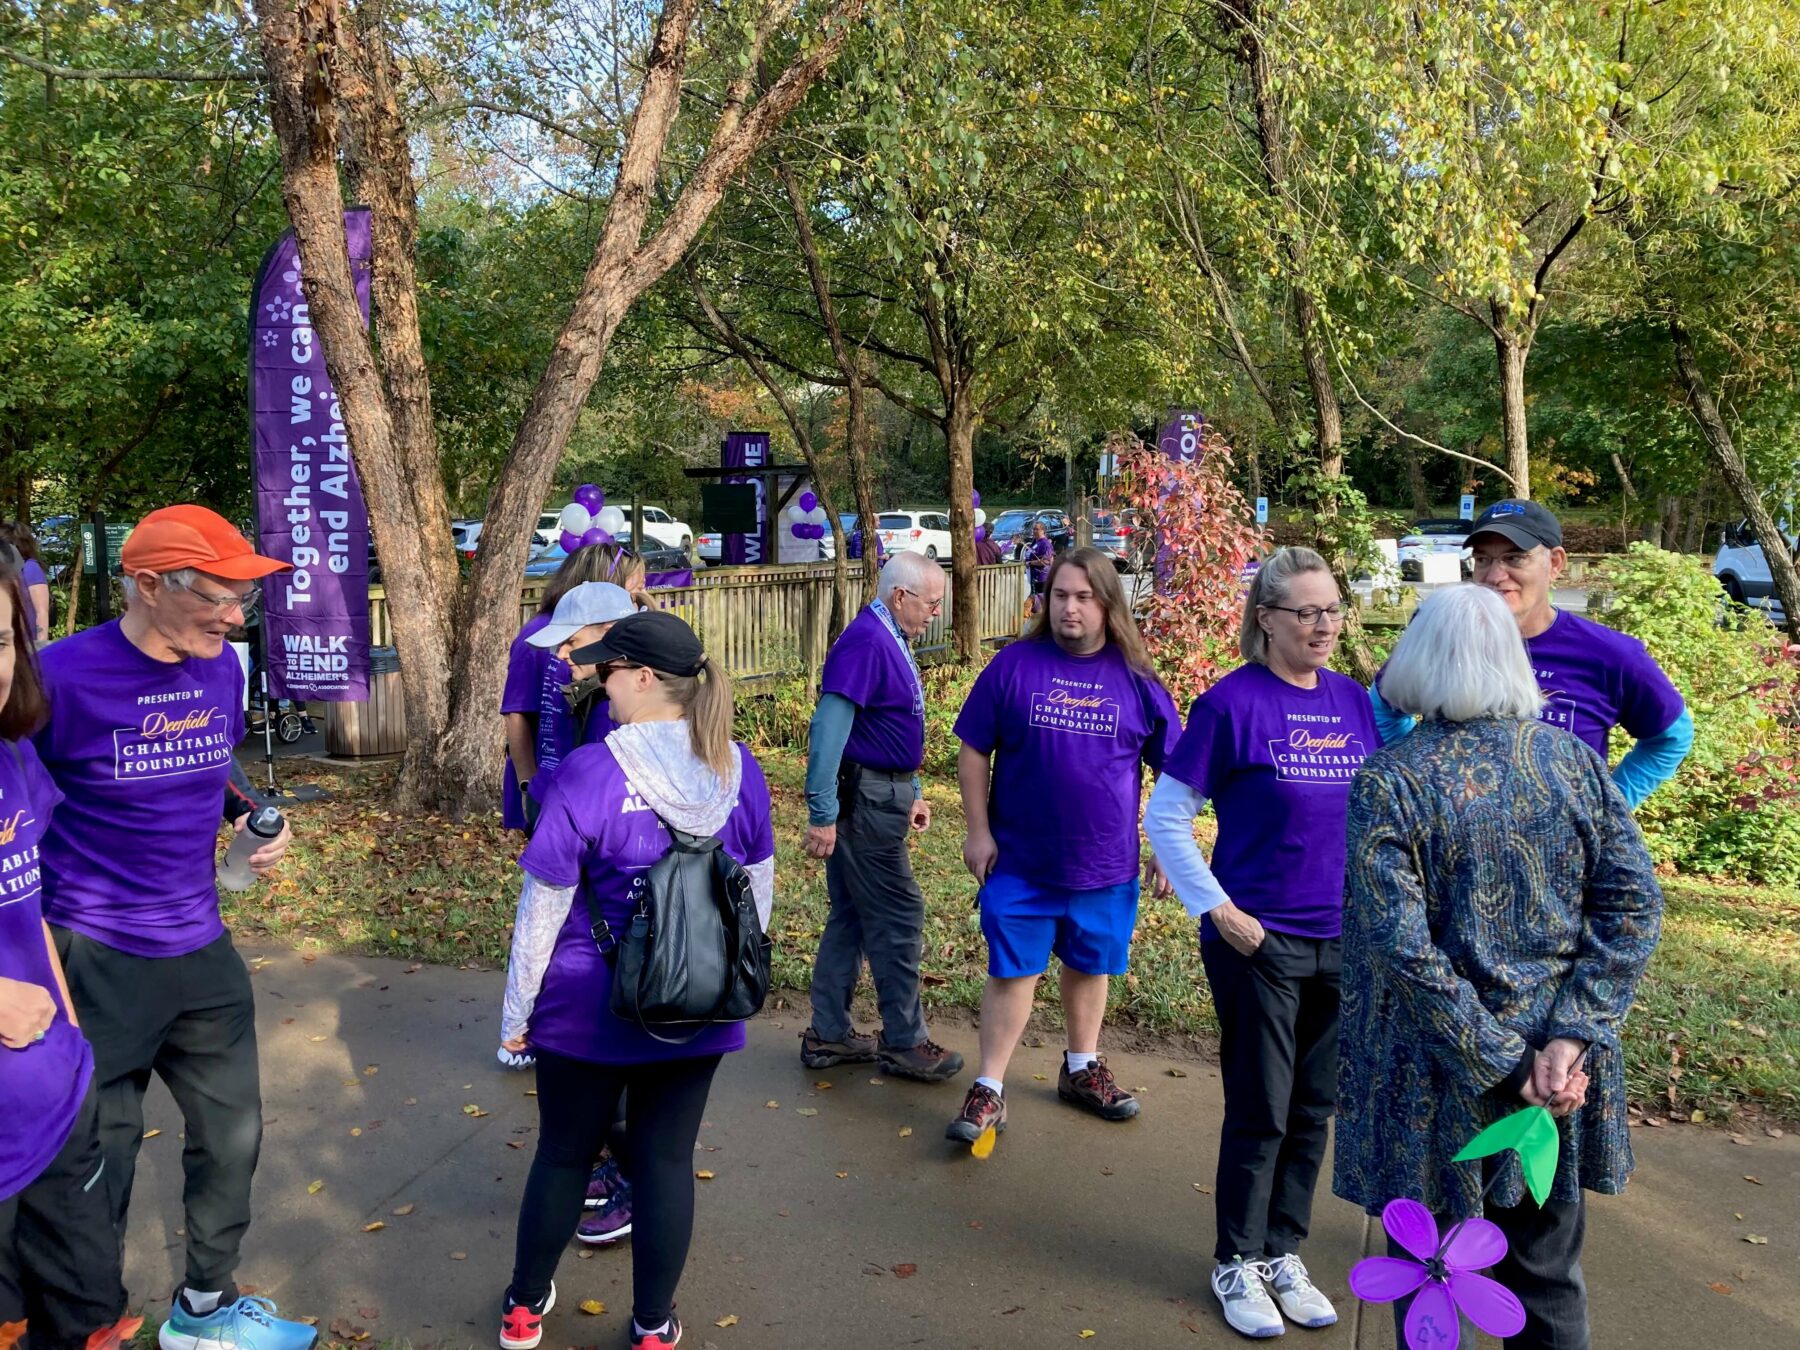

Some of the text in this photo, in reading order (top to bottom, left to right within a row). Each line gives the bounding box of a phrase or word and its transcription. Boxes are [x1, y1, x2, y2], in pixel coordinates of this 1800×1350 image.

[283, 303, 319, 610] Together, we can
[320, 382, 349, 574] end Alzhei
[282, 634, 349, 653] WALK
[287, 654, 349, 672] TO END
[285, 671, 350, 681] ALZHEIMER'S
[1052, 677, 1104, 691] PRESENTED BY
[1540, 670, 1555, 679] BY
[137, 689, 204, 706] PRESENTED BY
[1046, 688, 1114, 711] Deerfield
[1035, 704, 1115, 723] CHARITABLE
[1287, 713, 1342, 724] PRESENTED BY
[140, 706, 219, 741] Deerfield
[1034, 714, 1113, 733] FOUNDATION
[123, 732, 225, 757] CHARITABLE
[1288, 728, 1356, 755] Deerfield
[124, 747, 230, 773] FOUNDATION
[1281, 766, 1359, 778] FOUNDATIO
